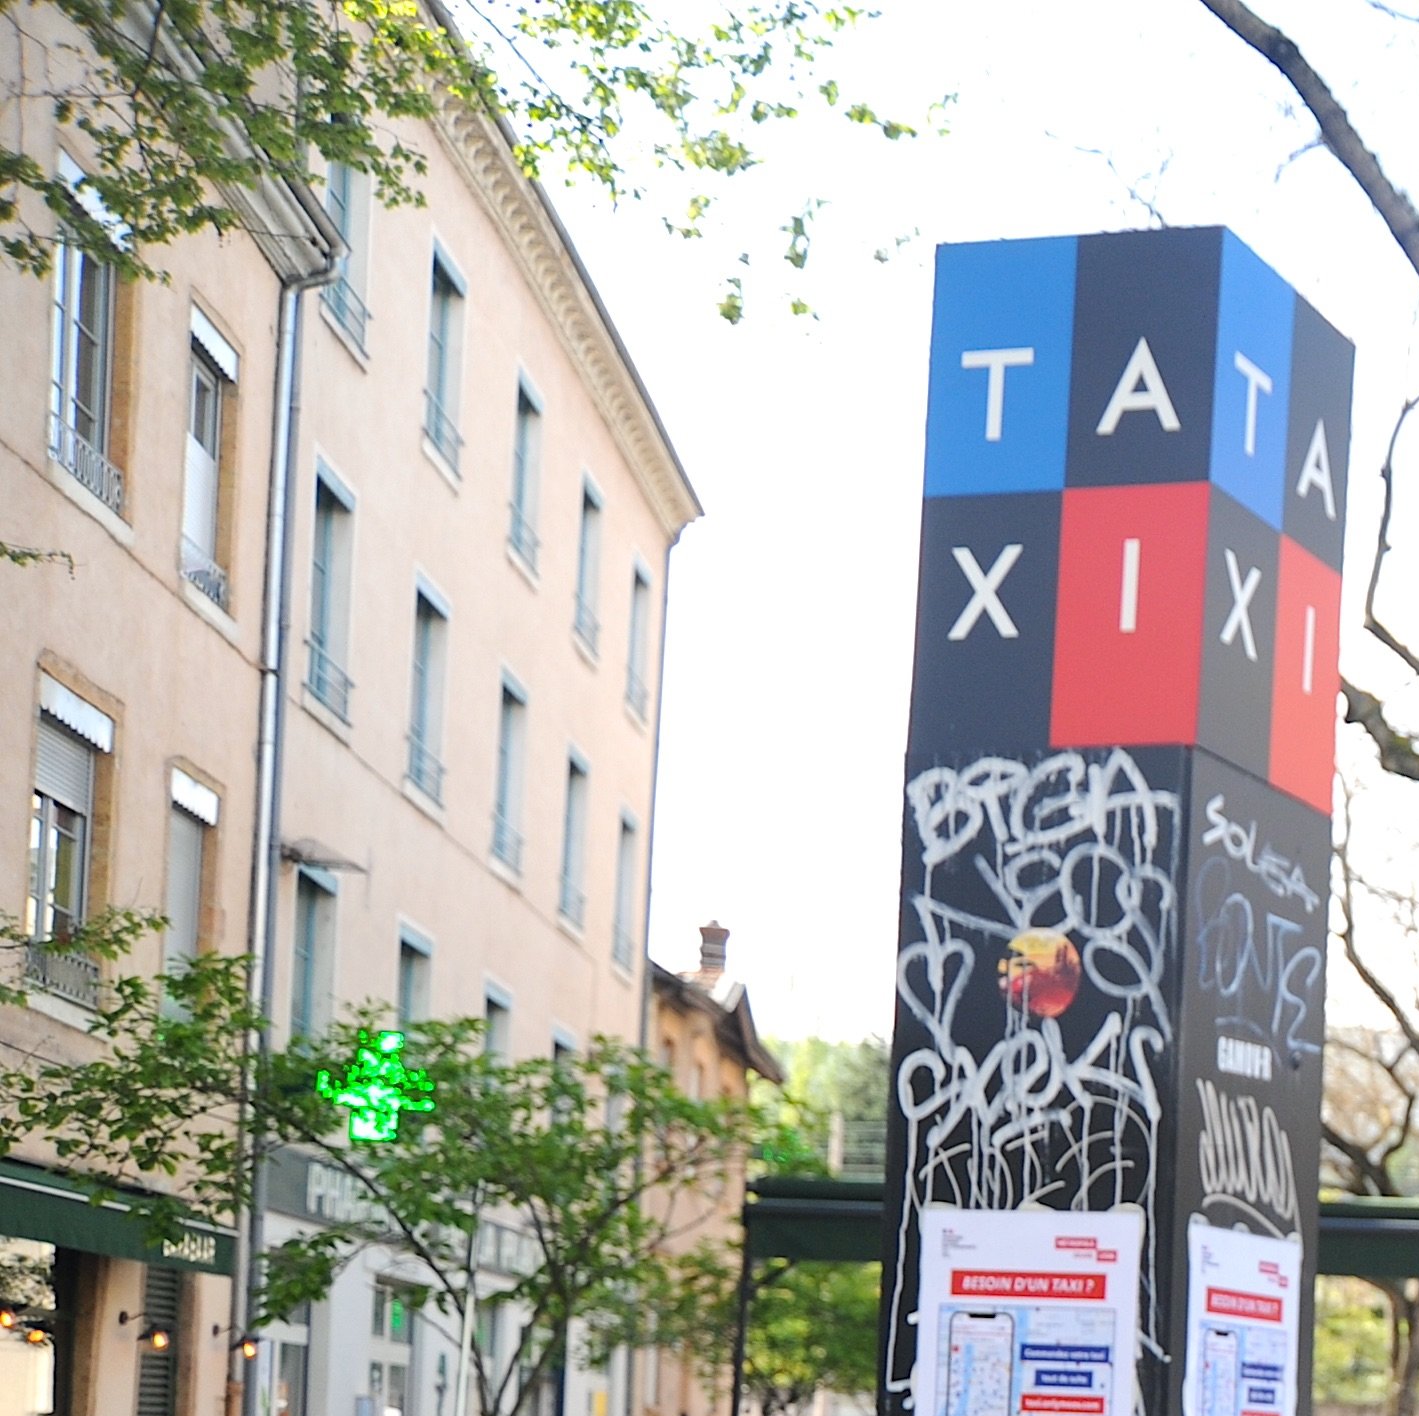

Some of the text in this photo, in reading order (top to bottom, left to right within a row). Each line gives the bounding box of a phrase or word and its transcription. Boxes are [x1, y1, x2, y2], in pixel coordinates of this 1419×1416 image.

[962, 1275, 1012, 1292] BESOIN
[1013, 1277, 1049, 1292] D'UN
[1051, 1278, 1085, 1294] TAXI
